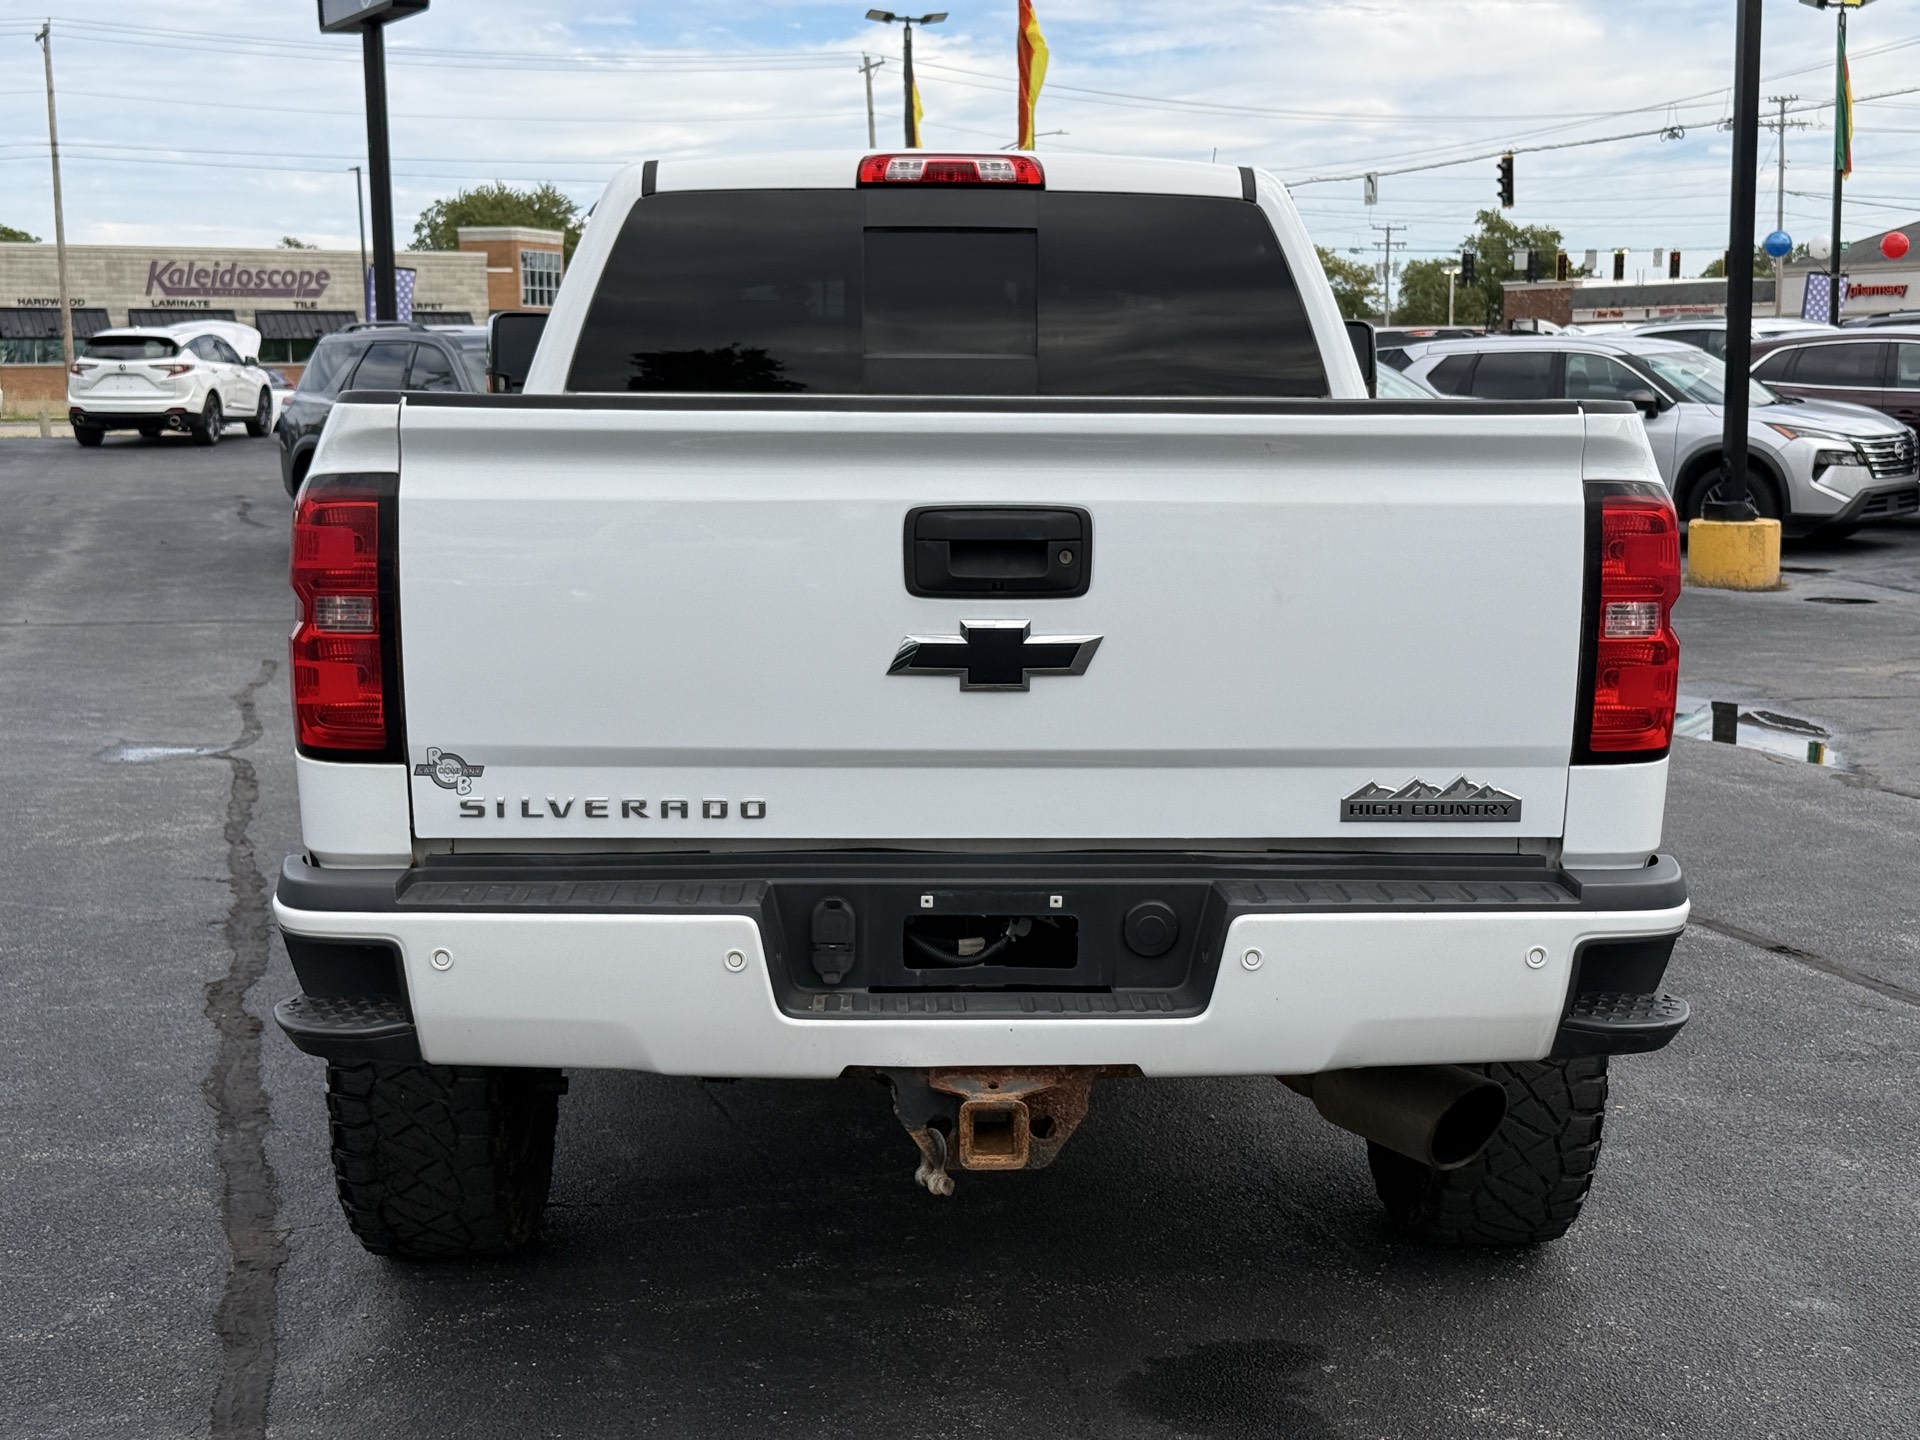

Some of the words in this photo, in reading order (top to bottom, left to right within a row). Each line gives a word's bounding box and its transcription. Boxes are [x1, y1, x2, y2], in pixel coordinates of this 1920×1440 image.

[145, 260, 331, 298] Kaleidoscope
[17, 298, 86, 307] HARDWOD
[151, 300, 211, 309] LAMINATE
[294, 301, 318, 310] TILE
[437, 766, 482, 775] COMPANY
[459, 796, 767, 819] SILVERADO
[1349, 804, 1402, 816] HIGH
[1411, 804, 1513, 816] COUNTRY
